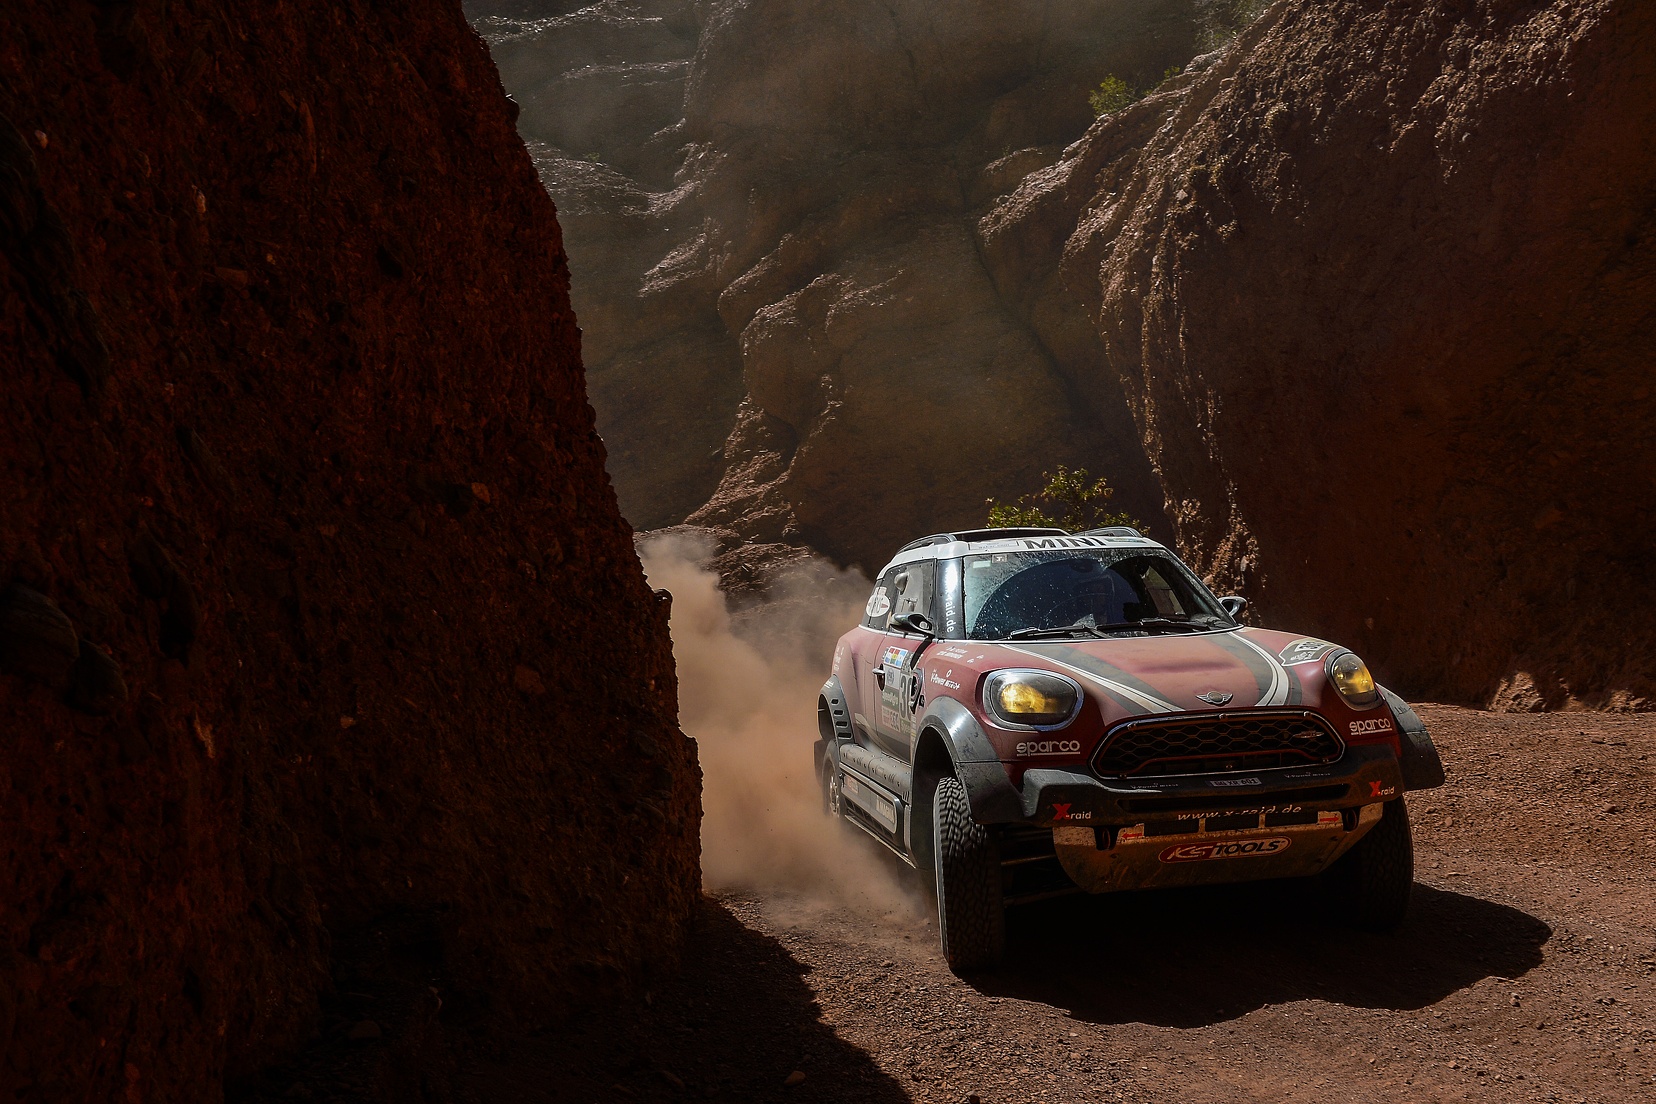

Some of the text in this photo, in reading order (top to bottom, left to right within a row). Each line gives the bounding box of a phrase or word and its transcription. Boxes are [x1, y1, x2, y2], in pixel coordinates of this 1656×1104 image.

[1023, 537, 1106, 549] MINI
[1348, 718, 1392, 736] sparco
[1016, 740, 1081, 757] sparco
[1052, 803, 1092, 820] X-raid
[1177, 804, 1302, 821] www.x-raid.de
